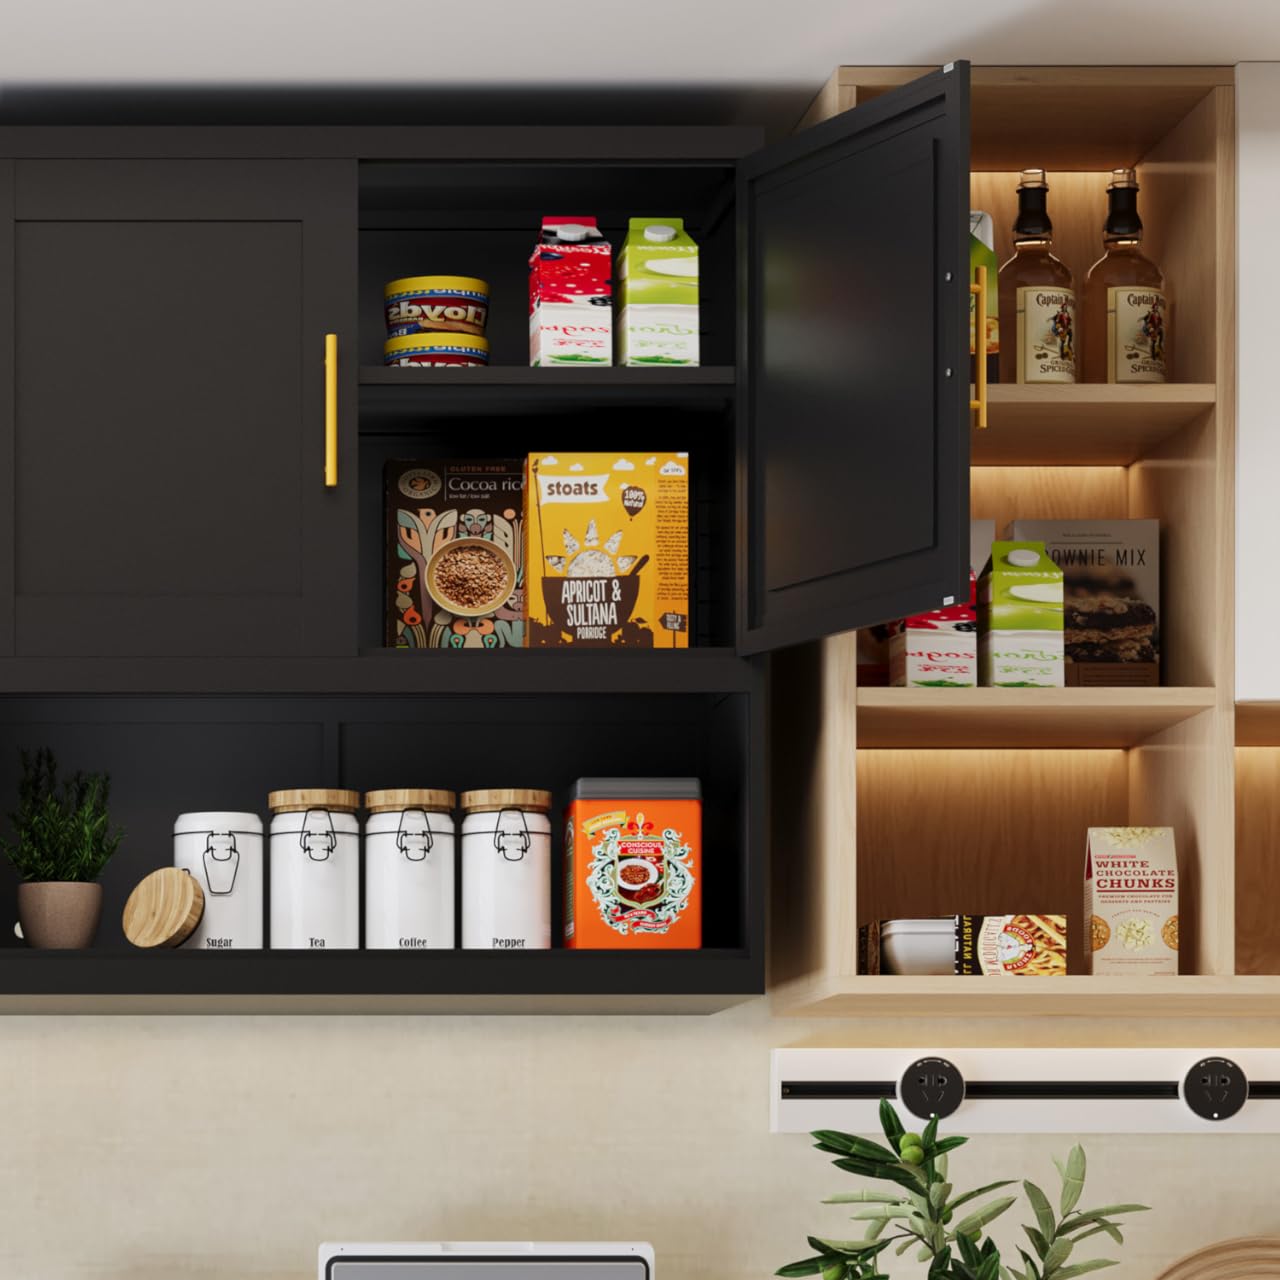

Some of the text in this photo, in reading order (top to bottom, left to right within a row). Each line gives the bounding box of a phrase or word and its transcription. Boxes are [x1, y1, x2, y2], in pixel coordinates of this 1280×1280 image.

[1036, 293, 1063, 307] Captain
[1127, 293, 1153, 307] Captain
[448, 477, 497, 491] Cocoa
[547, 480, 598, 497] stoats
[624, 490, 645, 501] 100%
[1045, 549, 1146, 566] OWNIE MIX
[561, 579, 622, 604] APRICOT &
[566, 602, 618, 627] SULTANA
[576, 627, 607, 639] PORRIDGE
[1095, 860, 1150, 868] WHITE
[1096, 878, 1175, 889] CHUNKS
[206, 937, 233, 948] Sugar
[309, 937, 325, 947] Tea
[399, 937, 427, 947] Coffee
[492, 937, 526, 948] Pepper
